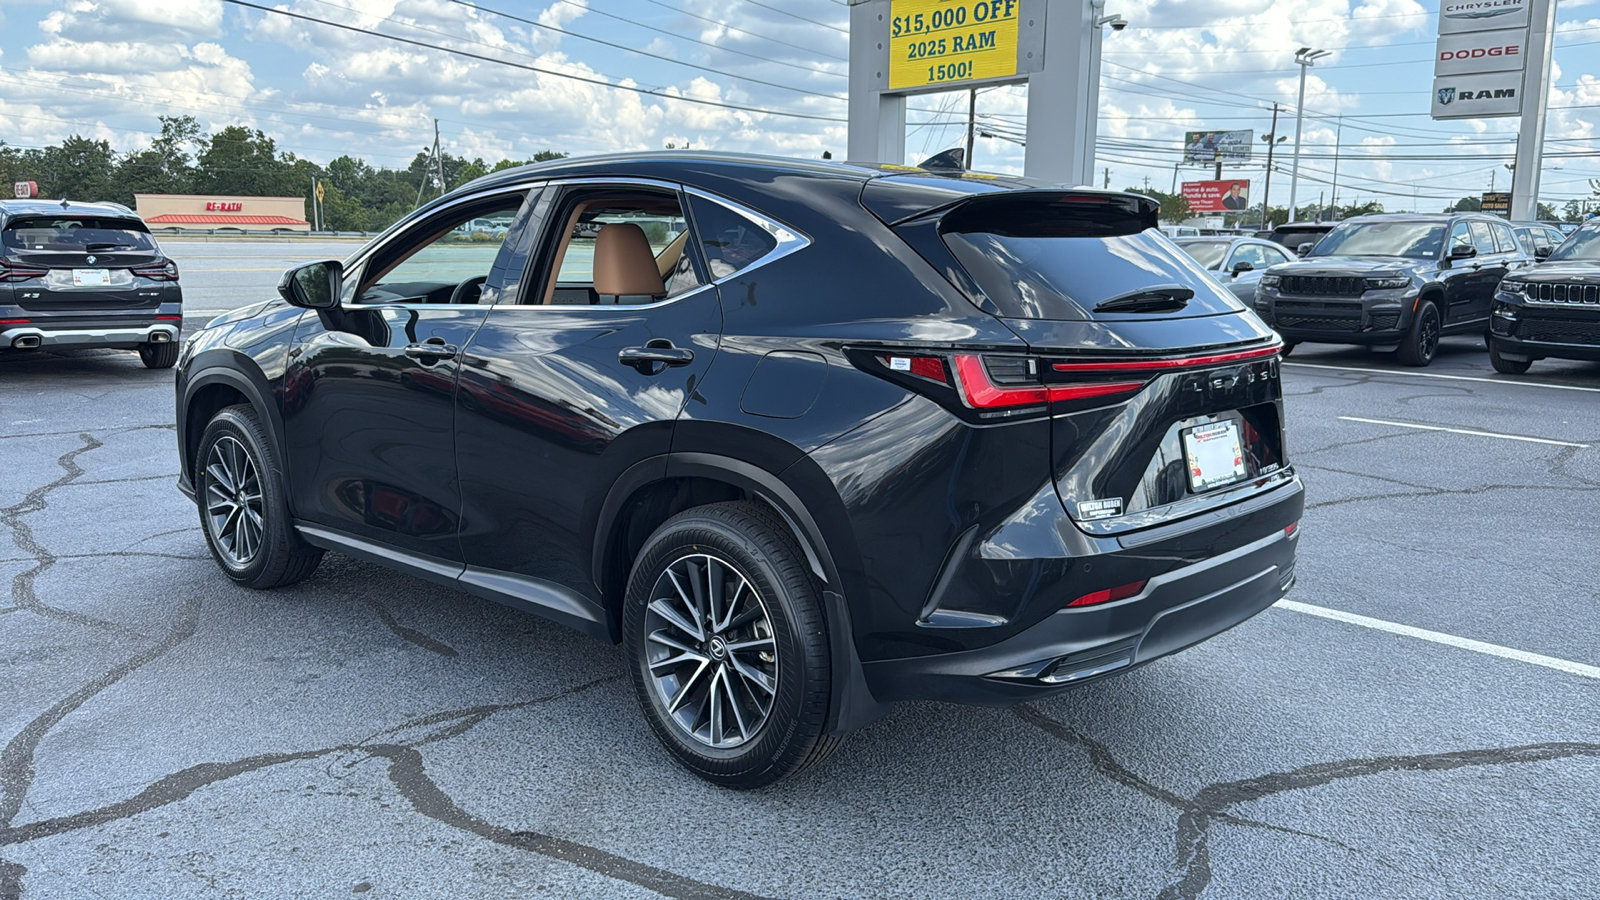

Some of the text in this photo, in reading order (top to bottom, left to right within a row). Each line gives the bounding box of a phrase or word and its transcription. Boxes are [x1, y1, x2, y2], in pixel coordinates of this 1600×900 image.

[1446, 0, 1521, 12] CHRYSLER
[892, 0, 1017, 37] $15,000 OFF
[908, 30, 996, 59] 2025 RAM
[1440, 45, 1519, 60] DODGE
[928, 60, 973, 82] 1500!
[1458, 88, 1515, 101] RAM
[1193, 371, 1268, 392] LEXUS
